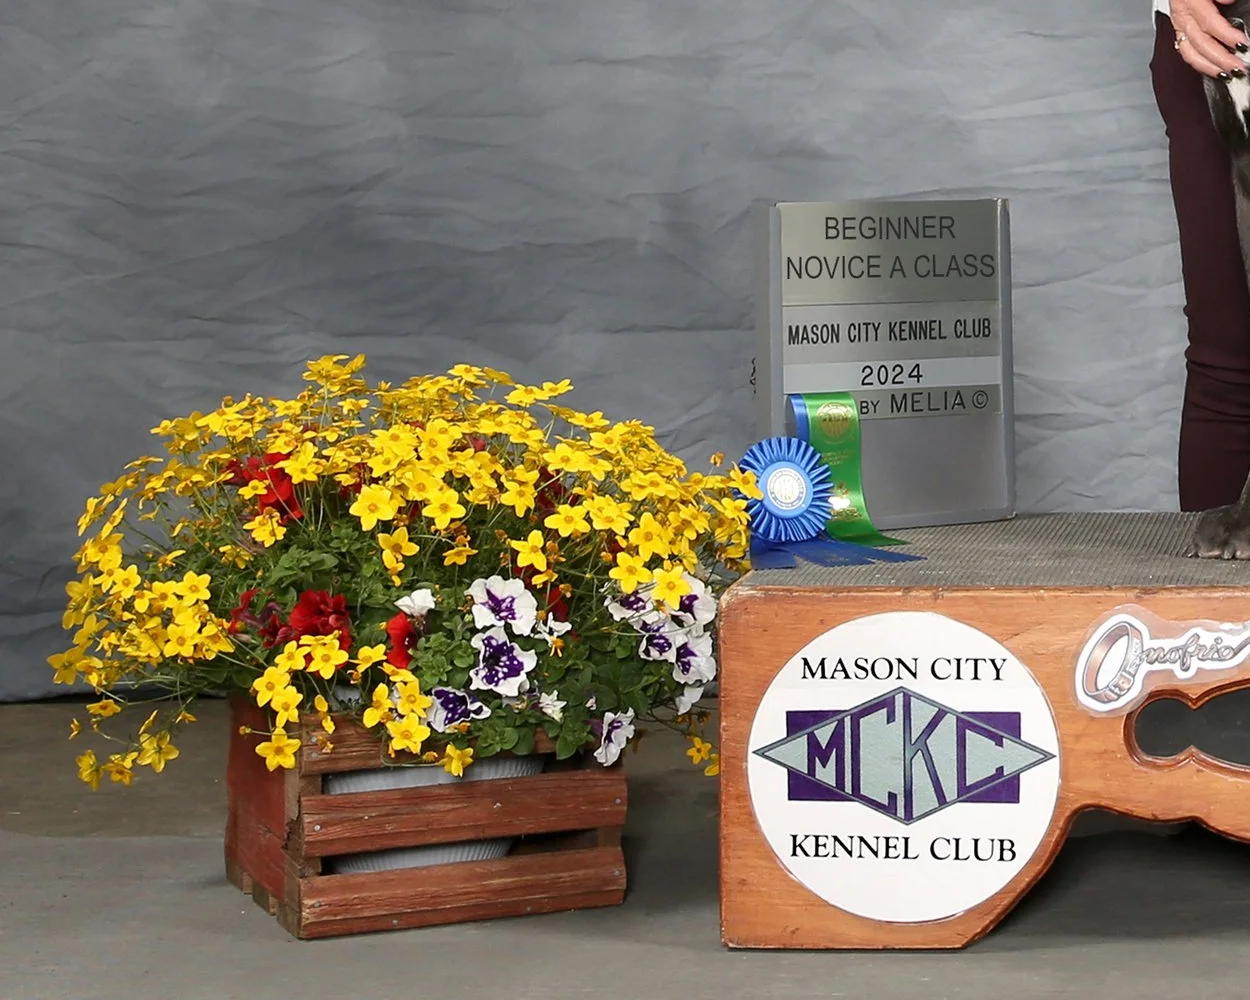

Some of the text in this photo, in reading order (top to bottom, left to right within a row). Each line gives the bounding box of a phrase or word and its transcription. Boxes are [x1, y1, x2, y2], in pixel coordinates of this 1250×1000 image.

[824, 215, 956, 241] BEGINNER
[786, 253, 996, 280] NOVICE A CLASS
[787, 317, 992, 346] MASON CITY KENNEL CLUB
[860, 363, 924, 386] 2024
[859, 399, 880, 415] BY
[890, 390, 966, 414] MELIA
[800, 656, 1009, 682] MASON CITY
[806, 690, 1005, 822] MCKC
[788, 833, 1018, 863] KENNEL CLUB
